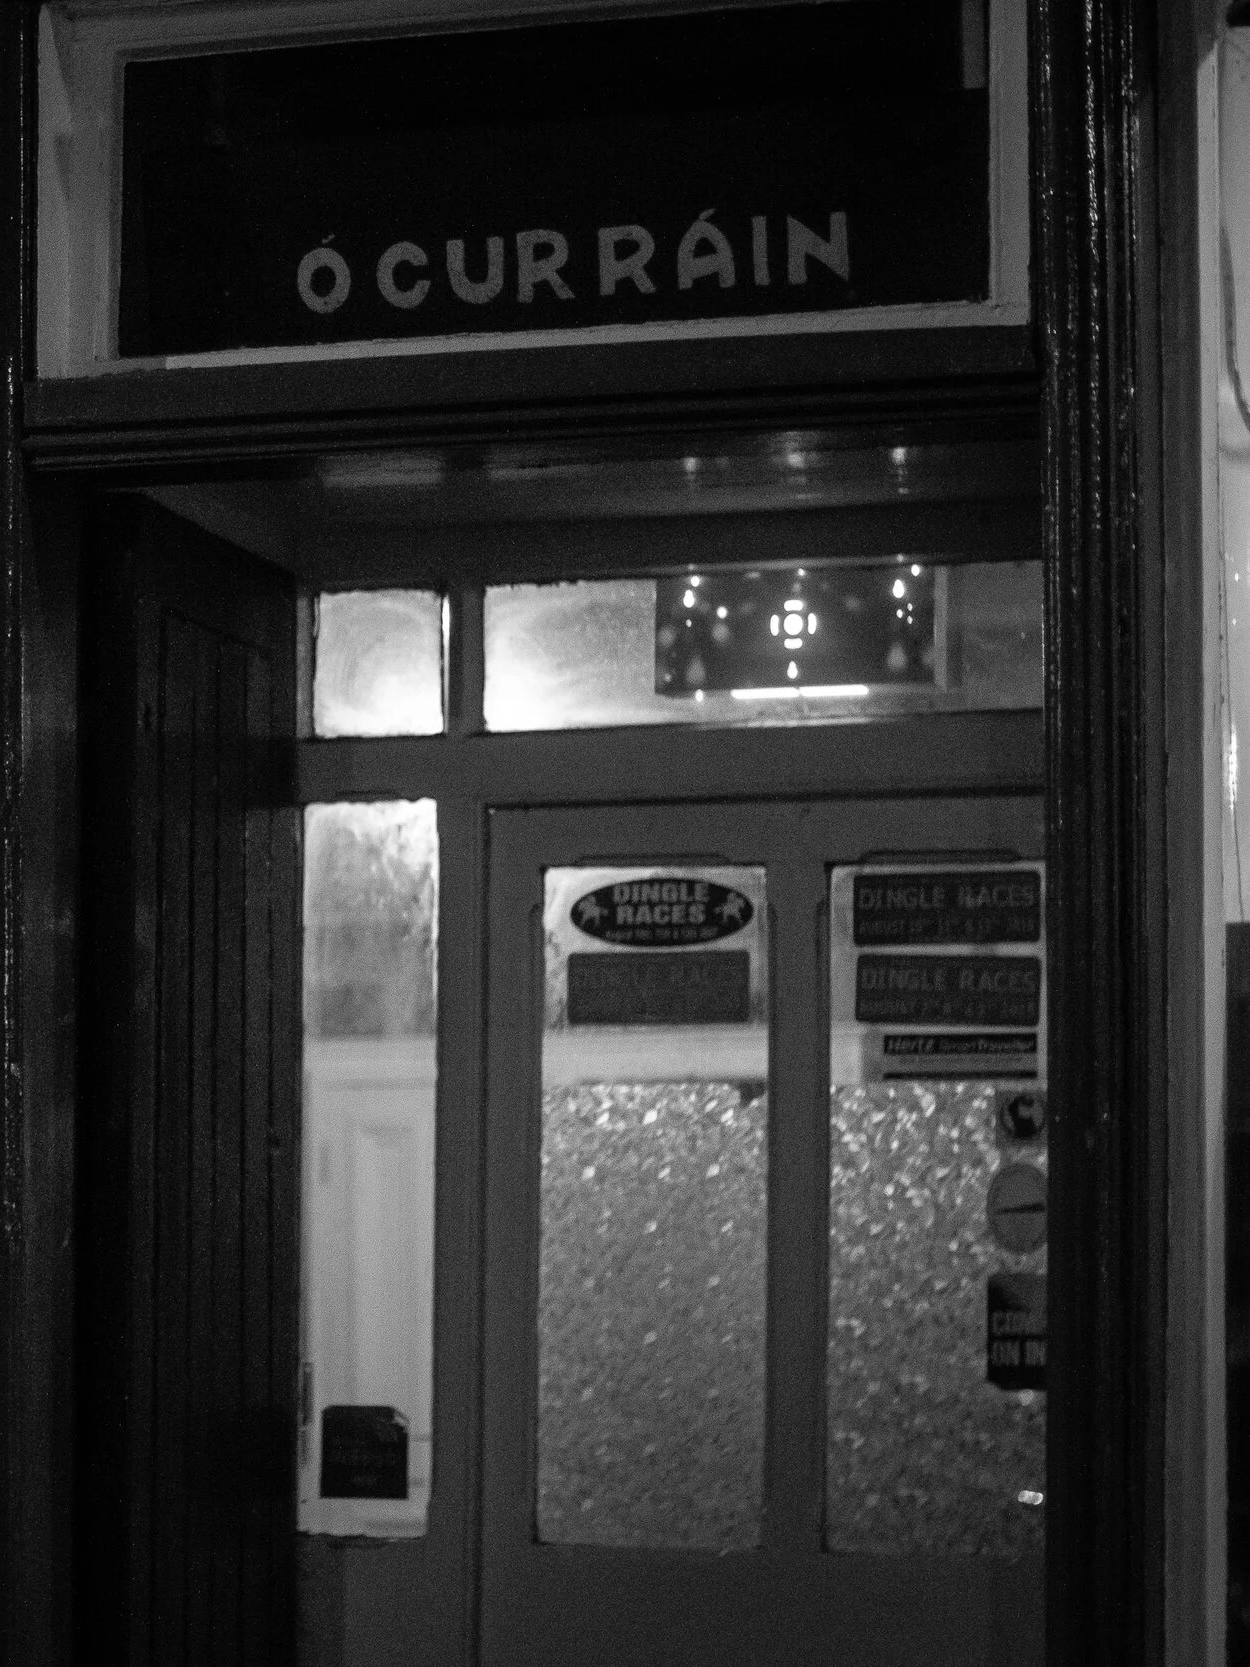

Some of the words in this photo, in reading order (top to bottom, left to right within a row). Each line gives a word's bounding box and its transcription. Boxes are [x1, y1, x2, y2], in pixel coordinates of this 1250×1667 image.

[297, 233, 352, 315] Ó
[376, 207, 853, 311] CURRÁIN
[613, 882, 709, 904] DINGLE
[859, 886, 946, 910] DINGLE
[957, 883, 1036, 910] RACES
[616, 904, 707, 926] RACES
[861, 967, 947, 991] DINGLE
[957, 967, 1038, 994] RACES
